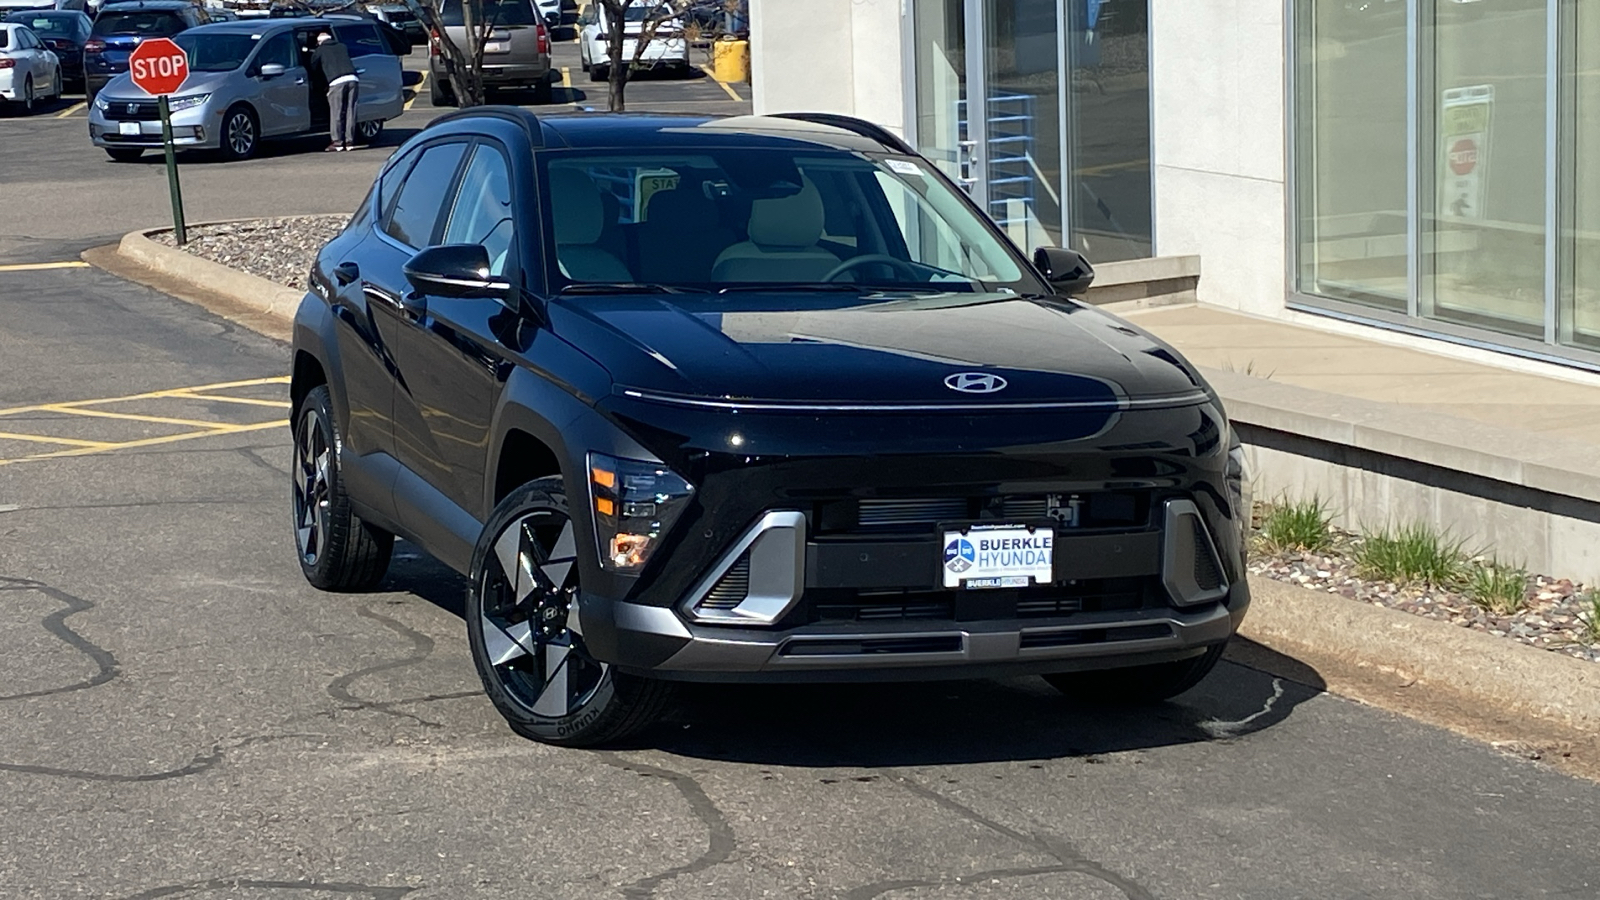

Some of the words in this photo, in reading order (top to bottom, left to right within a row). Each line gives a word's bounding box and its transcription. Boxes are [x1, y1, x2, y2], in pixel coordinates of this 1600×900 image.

[134, 55, 184, 79] STOP
[980, 537, 1052, 551] BUERKLE
[979, 550, 1052, 567] HYUNDAI
[557, 706, 600, 736] KUMHO
